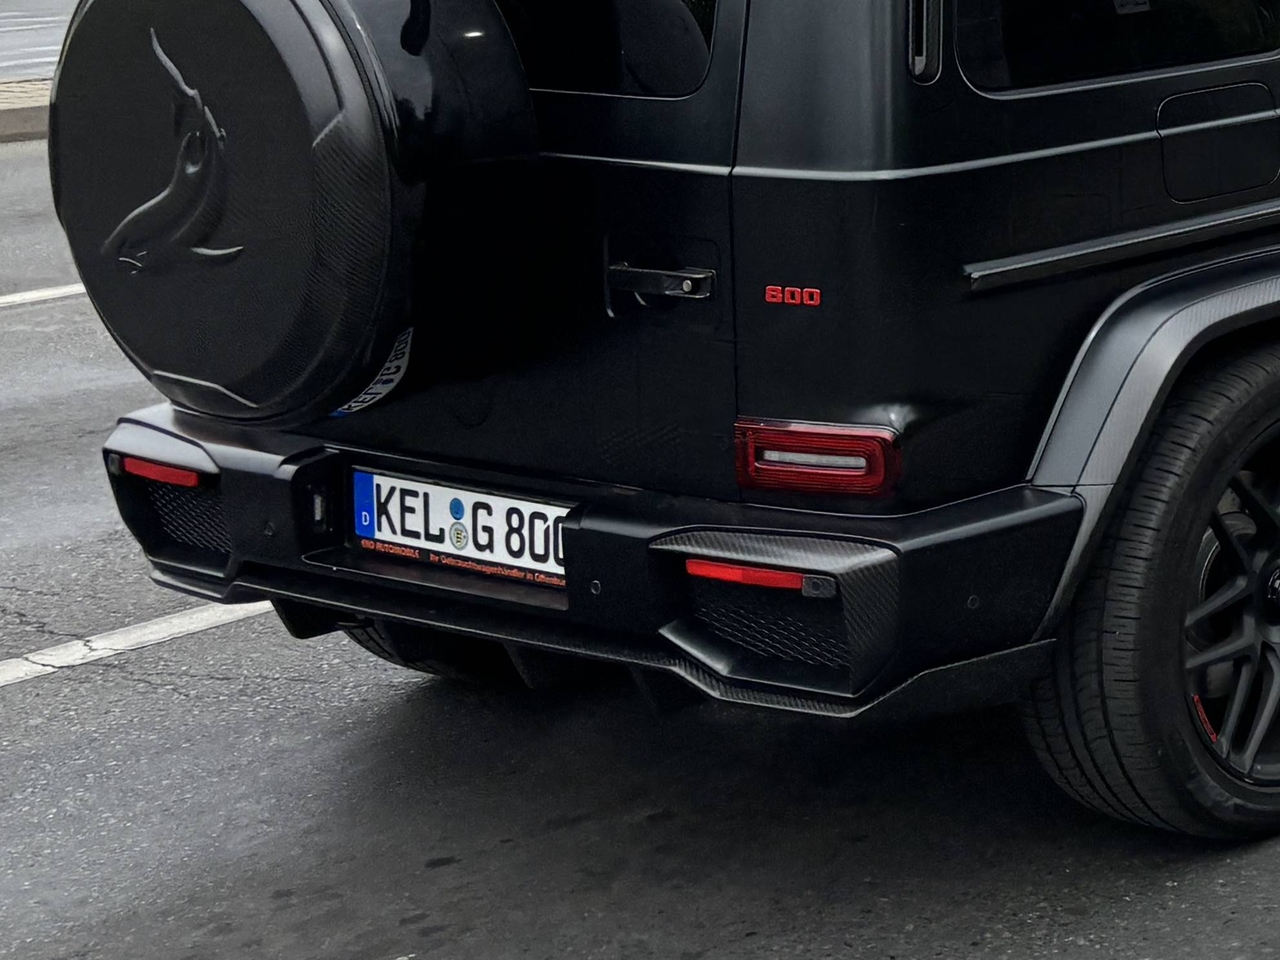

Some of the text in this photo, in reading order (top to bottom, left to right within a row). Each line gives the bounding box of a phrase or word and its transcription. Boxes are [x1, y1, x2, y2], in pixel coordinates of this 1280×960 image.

[361, 511, 370, 525] D
[375, 483, 445, 544] KEL
[472, 501, 494, 553] G
